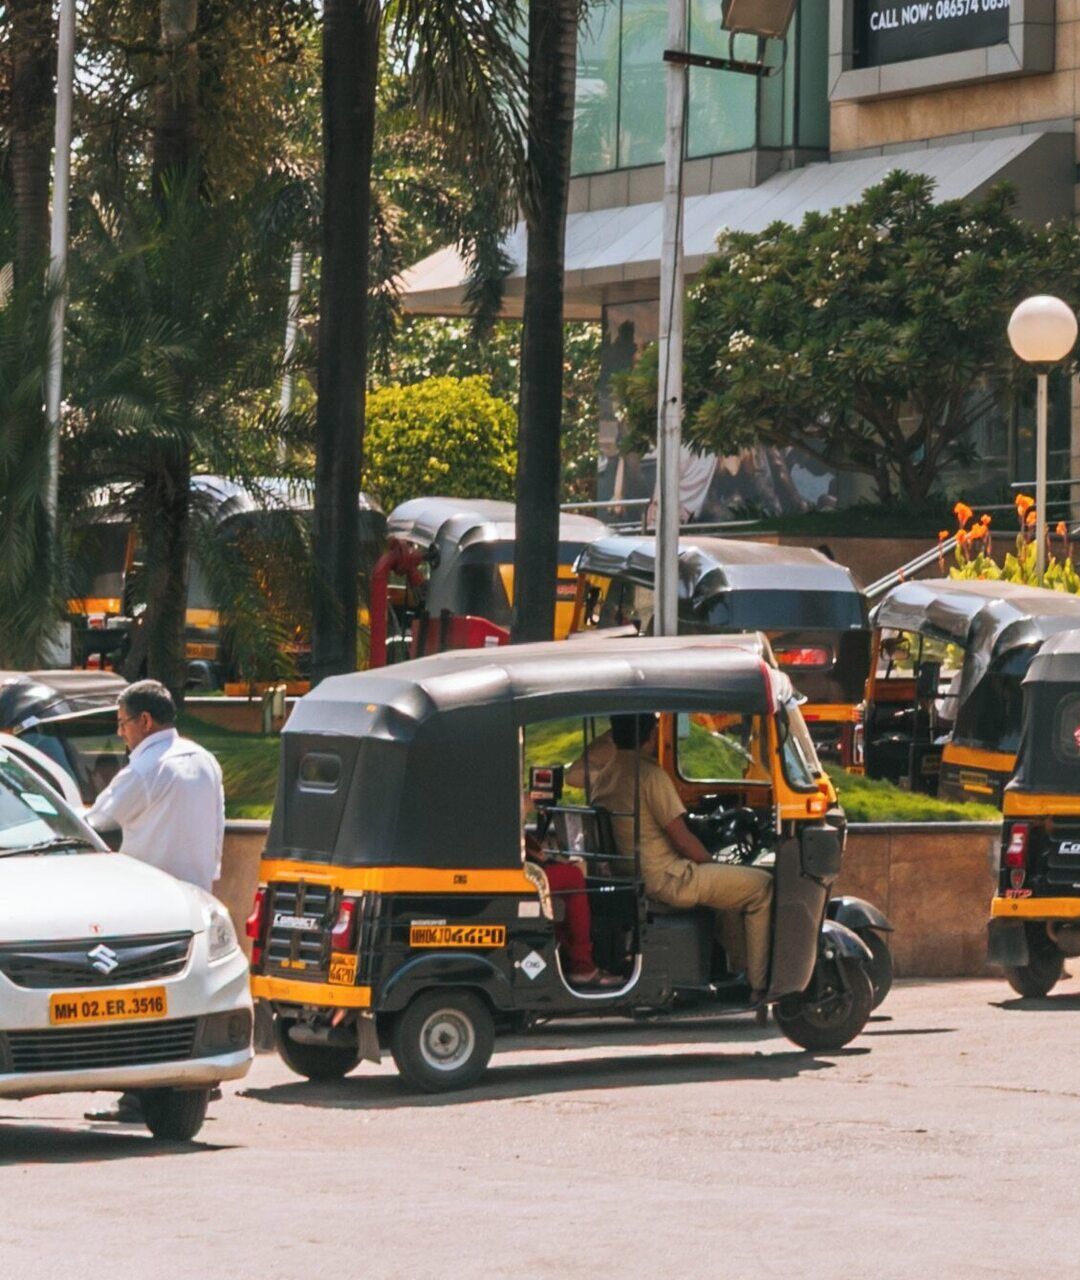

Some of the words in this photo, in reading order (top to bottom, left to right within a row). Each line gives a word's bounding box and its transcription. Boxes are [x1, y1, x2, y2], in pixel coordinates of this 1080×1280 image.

[870, 8, 899, 31] CALL
[901, 2, 933, 26] NOW:
[55, 1002, 77, 1020] MH
